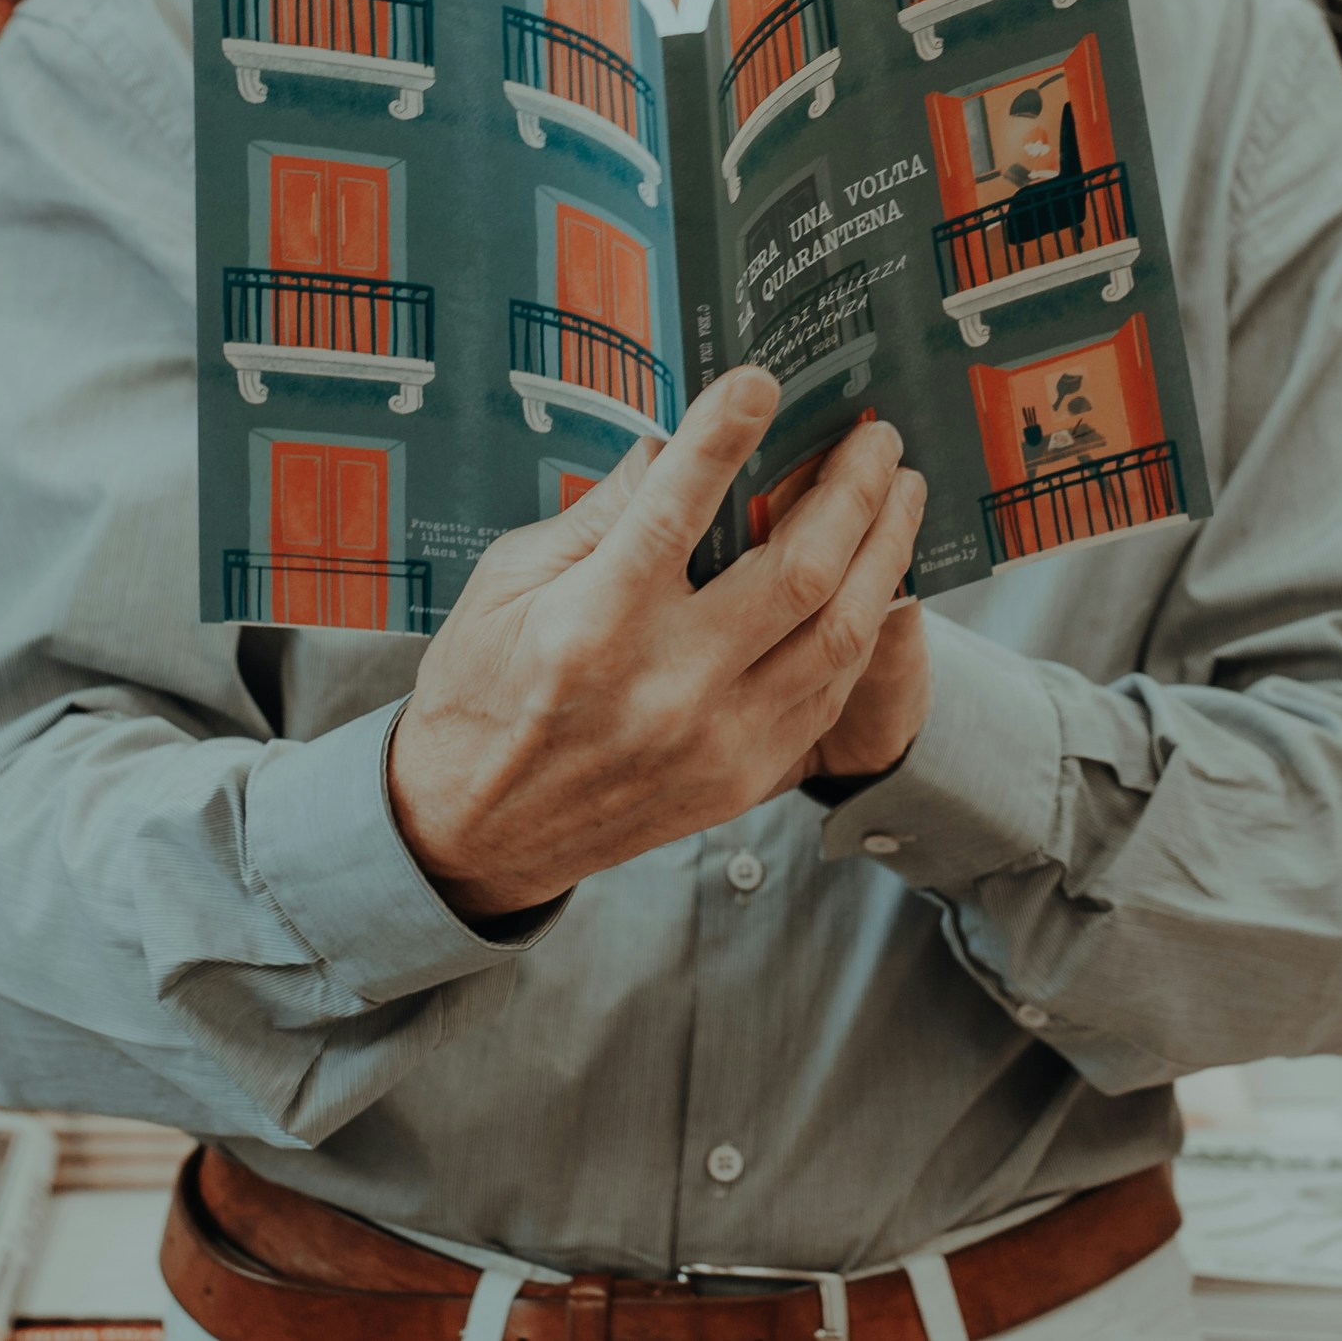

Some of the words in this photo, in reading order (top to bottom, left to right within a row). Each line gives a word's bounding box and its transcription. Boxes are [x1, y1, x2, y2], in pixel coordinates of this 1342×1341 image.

[788, 199, 834, 244] UNA
[843, 153, 929, 208] VOLTA
[760, 198, 906, 303] QUARANTENA
[789, 304, 812, 333] DI
[817, 254, 909, 311] BELLEZZA
[812, 333, 840, 357] 2020
[410, 518, 471, 534] Progetto
[421, 544, 458, 559] Auca
[930, 540, 958, 556] cura
[962, 531, 977, 545] di
